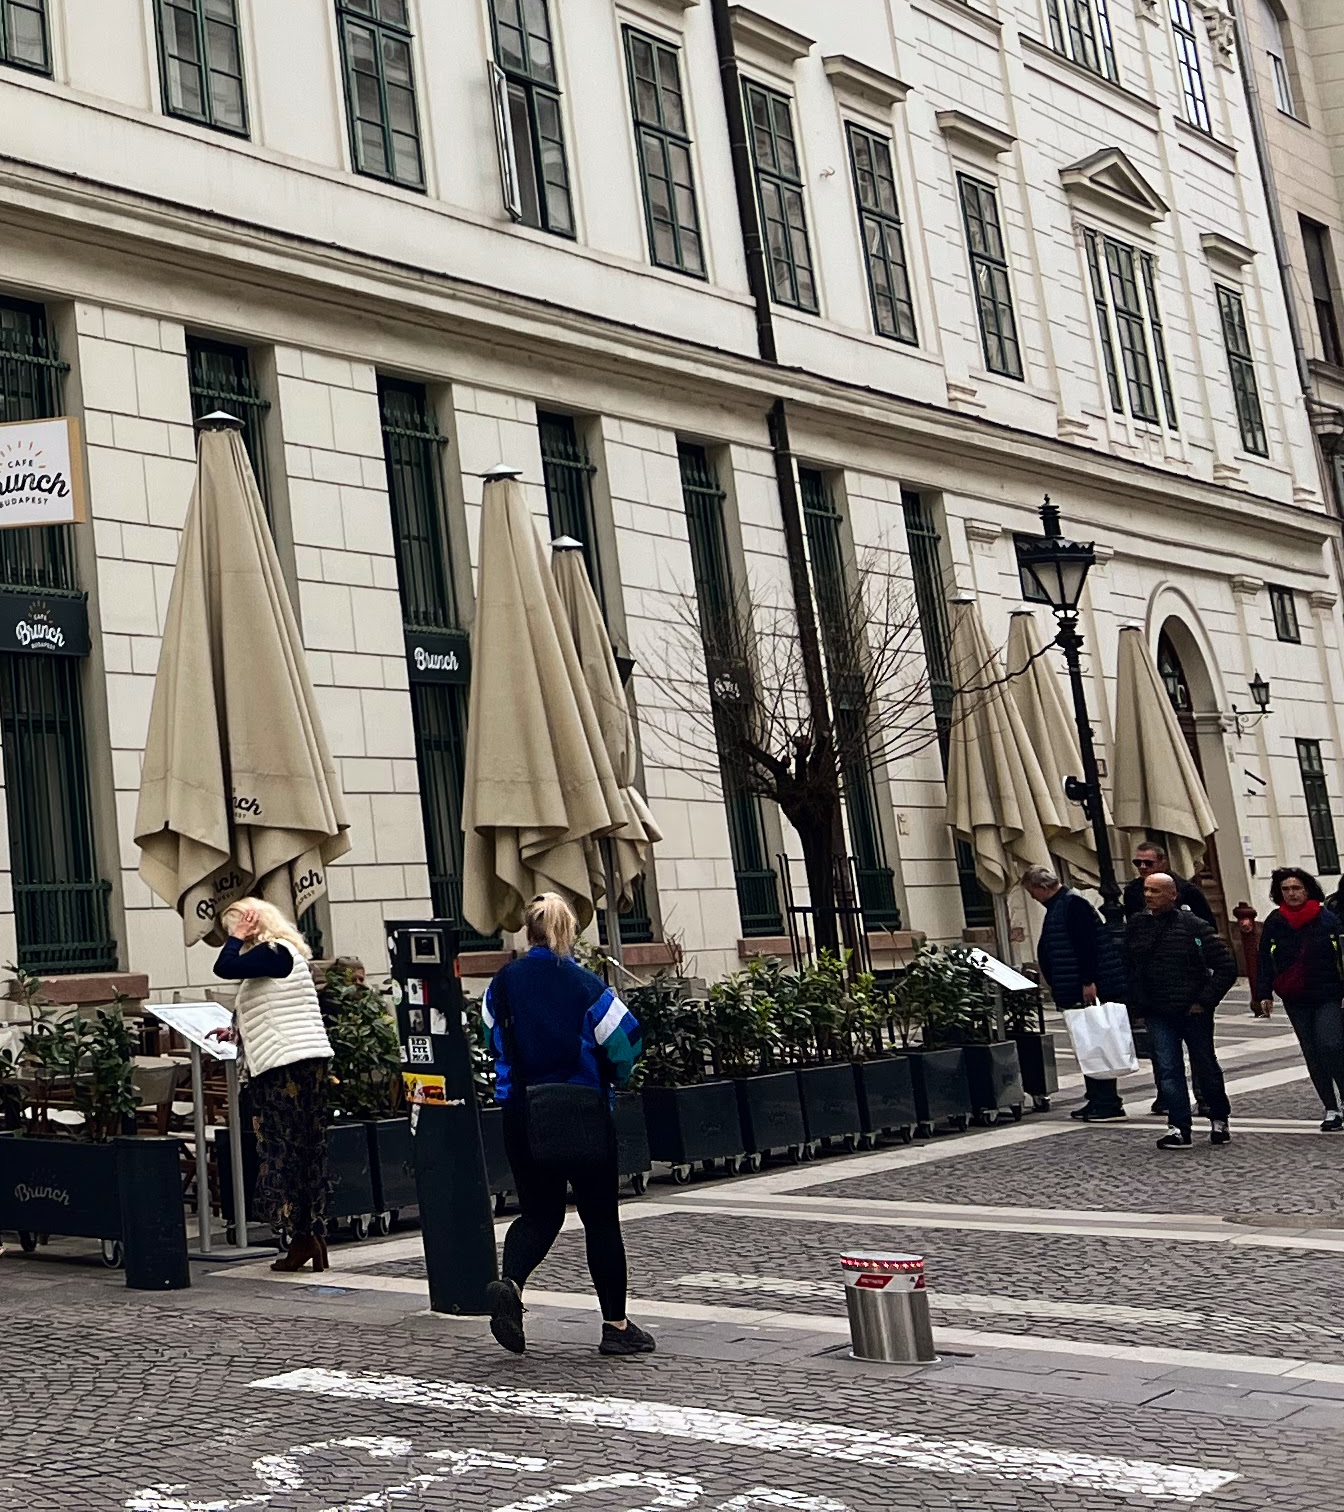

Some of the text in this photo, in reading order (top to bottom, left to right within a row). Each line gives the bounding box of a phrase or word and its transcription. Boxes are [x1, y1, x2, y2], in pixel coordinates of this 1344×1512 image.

[7, 459, 34, 469] CAFE
[16, 620, 66, 647] Brunch
[414, 646, 459, 671] Brunch
[15, 1183, 70, 1206] Brunch
